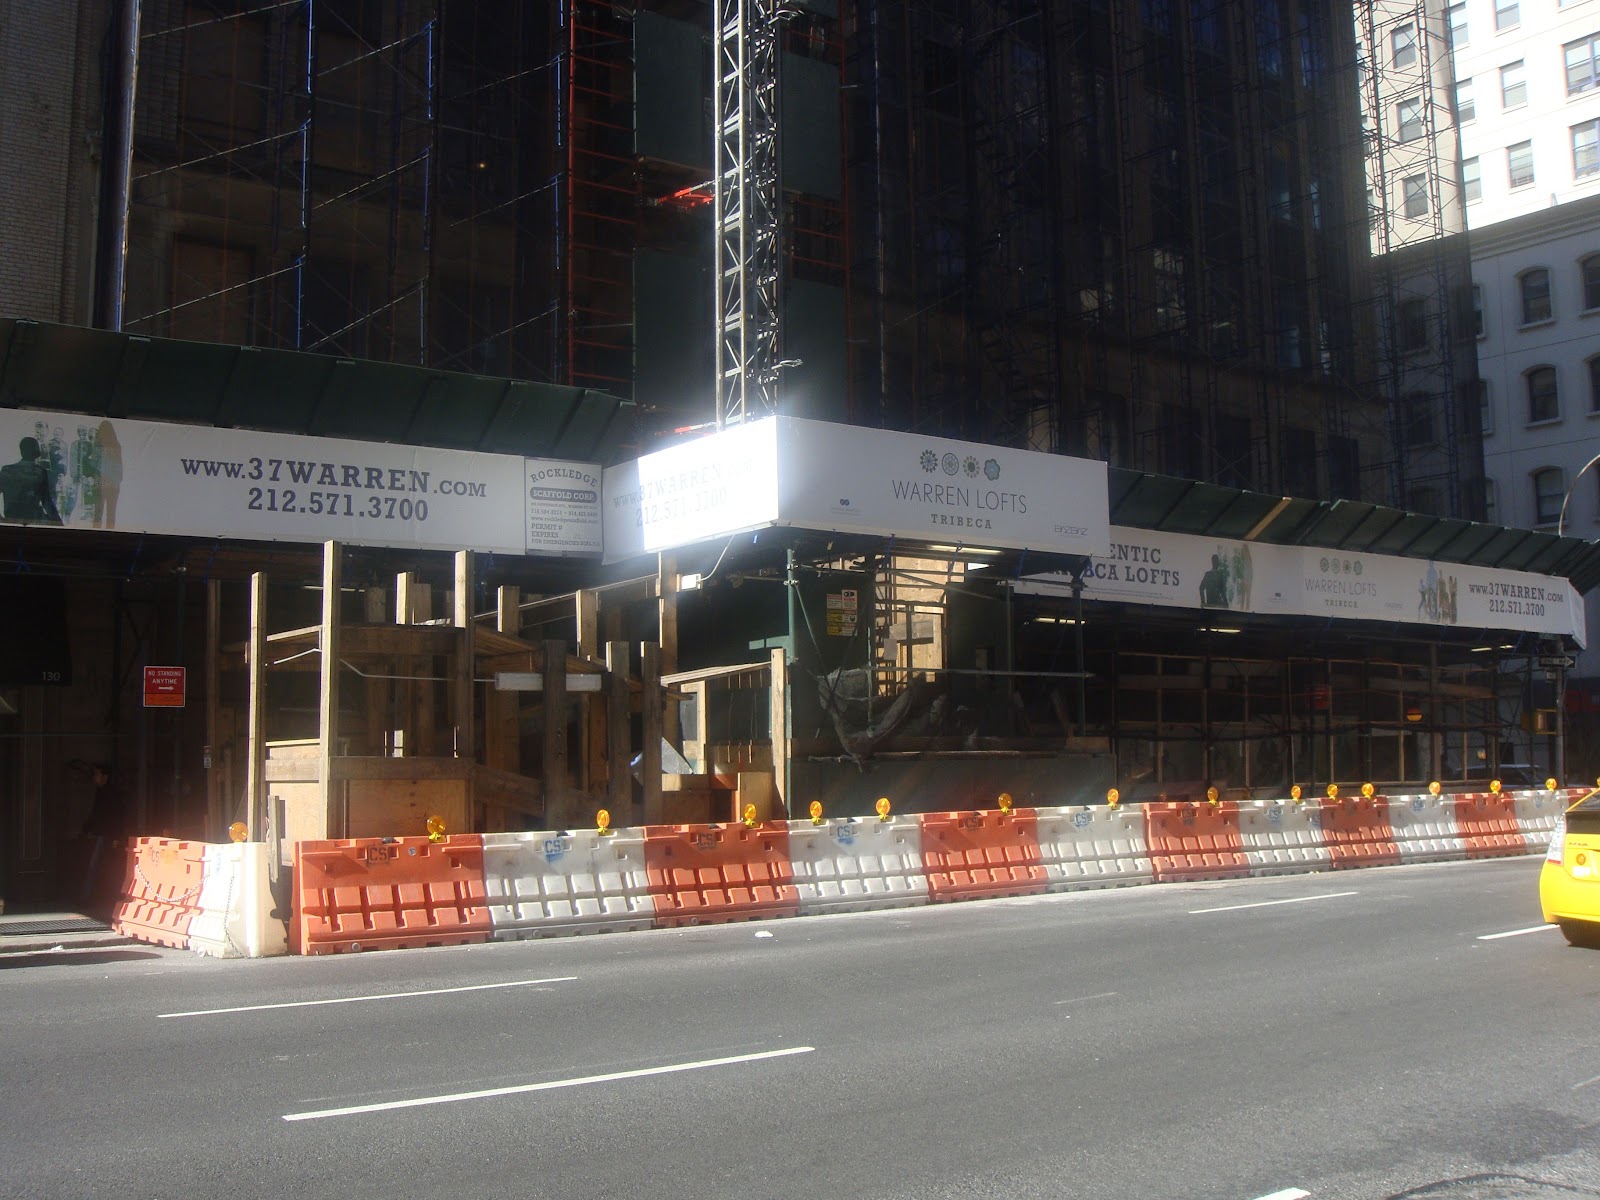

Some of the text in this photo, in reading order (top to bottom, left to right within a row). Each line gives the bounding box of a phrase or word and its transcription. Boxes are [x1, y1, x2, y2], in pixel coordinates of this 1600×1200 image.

[530, 468, 597, 487] ROCKLEDGE
[533, 489, 595, 501] SCAFFOLD CORP.
[892, 479, 1027, 514] WARREN LOFTS
[248, 487, 428, 522] 212.571.3700
[531, 522, 557, 531] PERMIT
[931, 513, 992, 530] TRIBECA
[531, 530, 559, 538] EXPIRES
[1125, 566, 1180, 587] LOFTS
[1305, 578, 1377, 598] WARREN LOFTS
[1325, 599, 1358, 609] TRIBECA
[1489, 600, 1545, 617] 212.571.3700
[42, 671, 61, 682] 130
[836, 825, 850, 838] CS
[545, 839, 562, 854] CS
[697, 833, 714, 846] CS
[369, 847, 387, 862] CS
